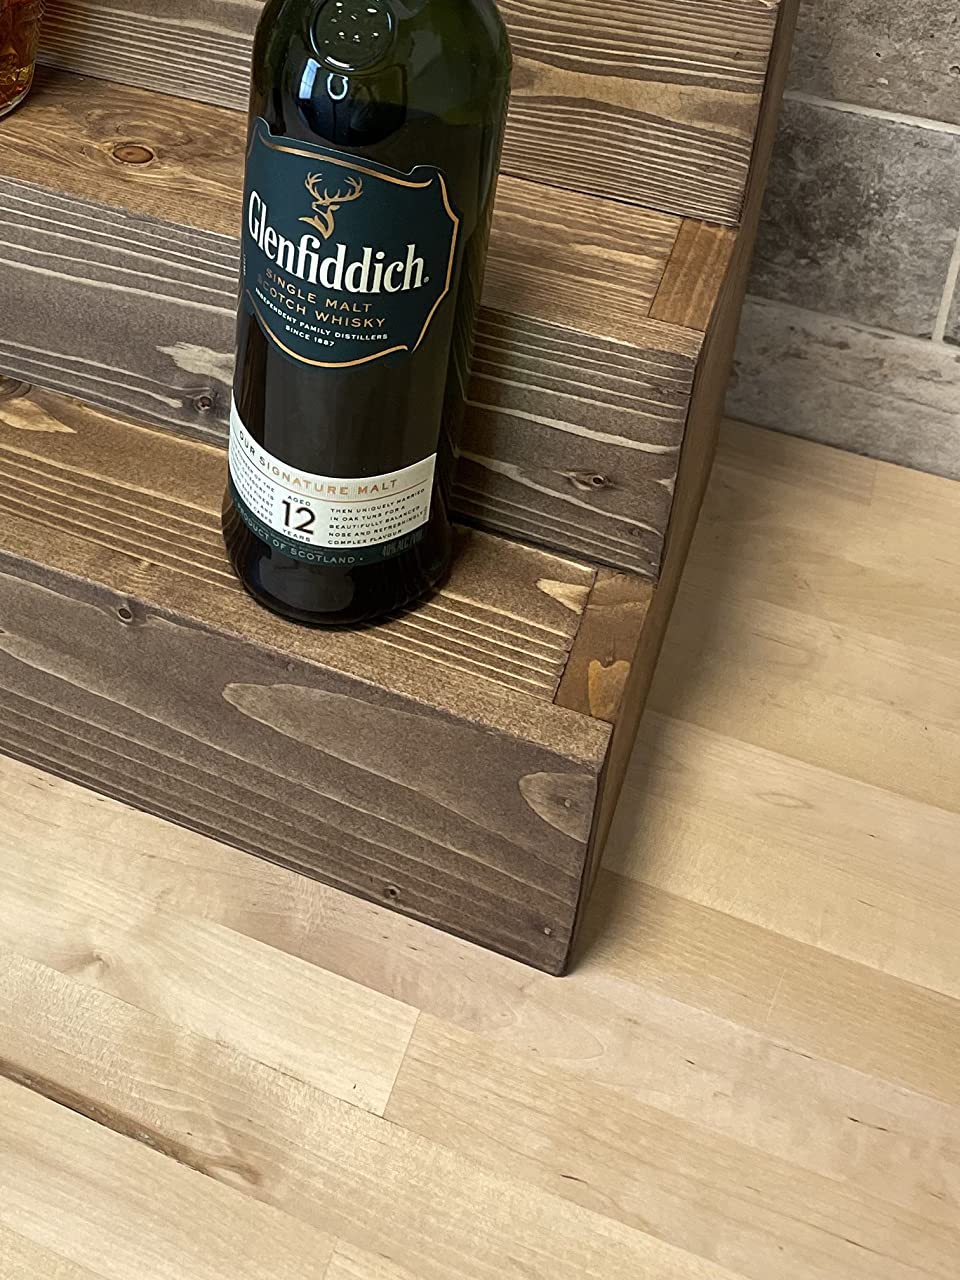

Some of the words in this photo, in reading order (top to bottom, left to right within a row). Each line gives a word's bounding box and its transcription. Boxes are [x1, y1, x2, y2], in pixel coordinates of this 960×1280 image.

[248, 190, 427, 294] Glenfiddich
[257, 273, 306, 315] SCOTCH
[314, 310, 385, 328] WHISKY
[266, 268, 317, 304] SINGLE
[325, 298, 373, 313] MALT
[255, 287, 297, 324] INDEPENDENT
[299, 321, 331, 336] FAMILY
[334, 331, 388, 340] DISTILLERS
[285, 325, 311, 341] SINCE
[314, 336, 335, 347] 1887
[239, 430, 256, 456] OUR
[259, 456, 349, 495] SIGNATURE
[357, 479, 398, 495] MALT
[287, 495, 312, 507] AGED
[356, 502, 394, 513] UNIQUELY
[397, 488, 425, 504] MARRIED
[282, 500, 316, 535] 12
[329, 520, 382, 529] BEAUTIFULLY
[385, 505, 420, 523] BALANCED
[362, 512, 382, 521] TUNS
[385, 507, 399, 516] FOR
[374, 511, 424, 534] REFRESHINGLY
[237, 502, 270, 540] PRODUCT
[272, 539, 286, 549] OF
[290, 548, 356, 564] SCOTLAND
[282, 529, 311, 542] YEARS
[369, 529, 402, 542] FLAVOUR
